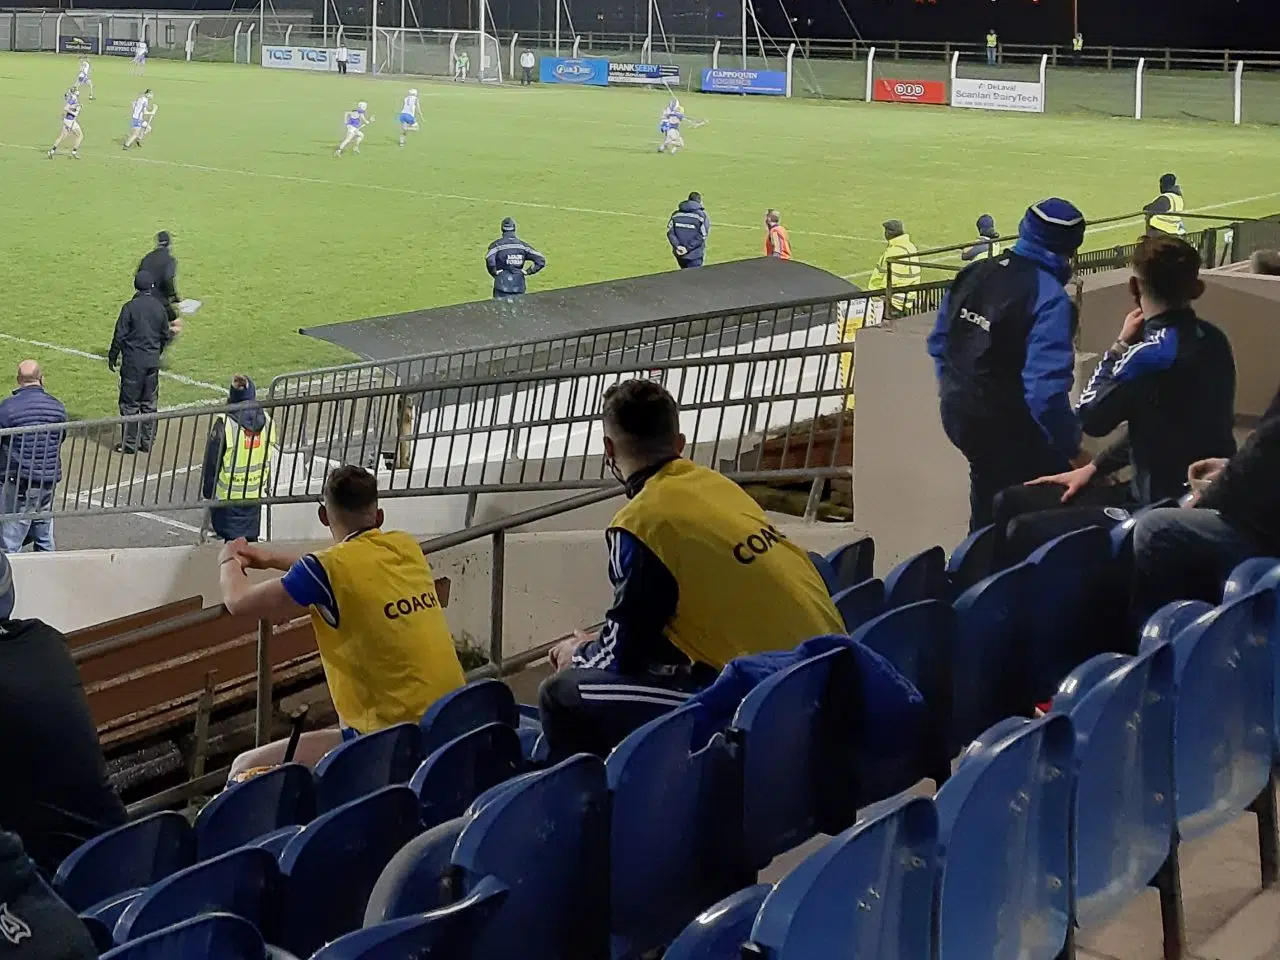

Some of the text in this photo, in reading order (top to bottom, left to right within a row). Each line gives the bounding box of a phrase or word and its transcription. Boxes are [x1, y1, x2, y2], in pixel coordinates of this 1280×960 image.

[267, 49, 293, 60] TQS
[298, 49, 327, 62] TQS
[609, 63, 658, 72] FRANK SEERY
[712, 71, 758, 80] CAPPOQUIN
[987, 83, 1016, 91] DeLaval
[956, 90, 990, 99] Scanlan
[384, 592, 437, 620] COACH
